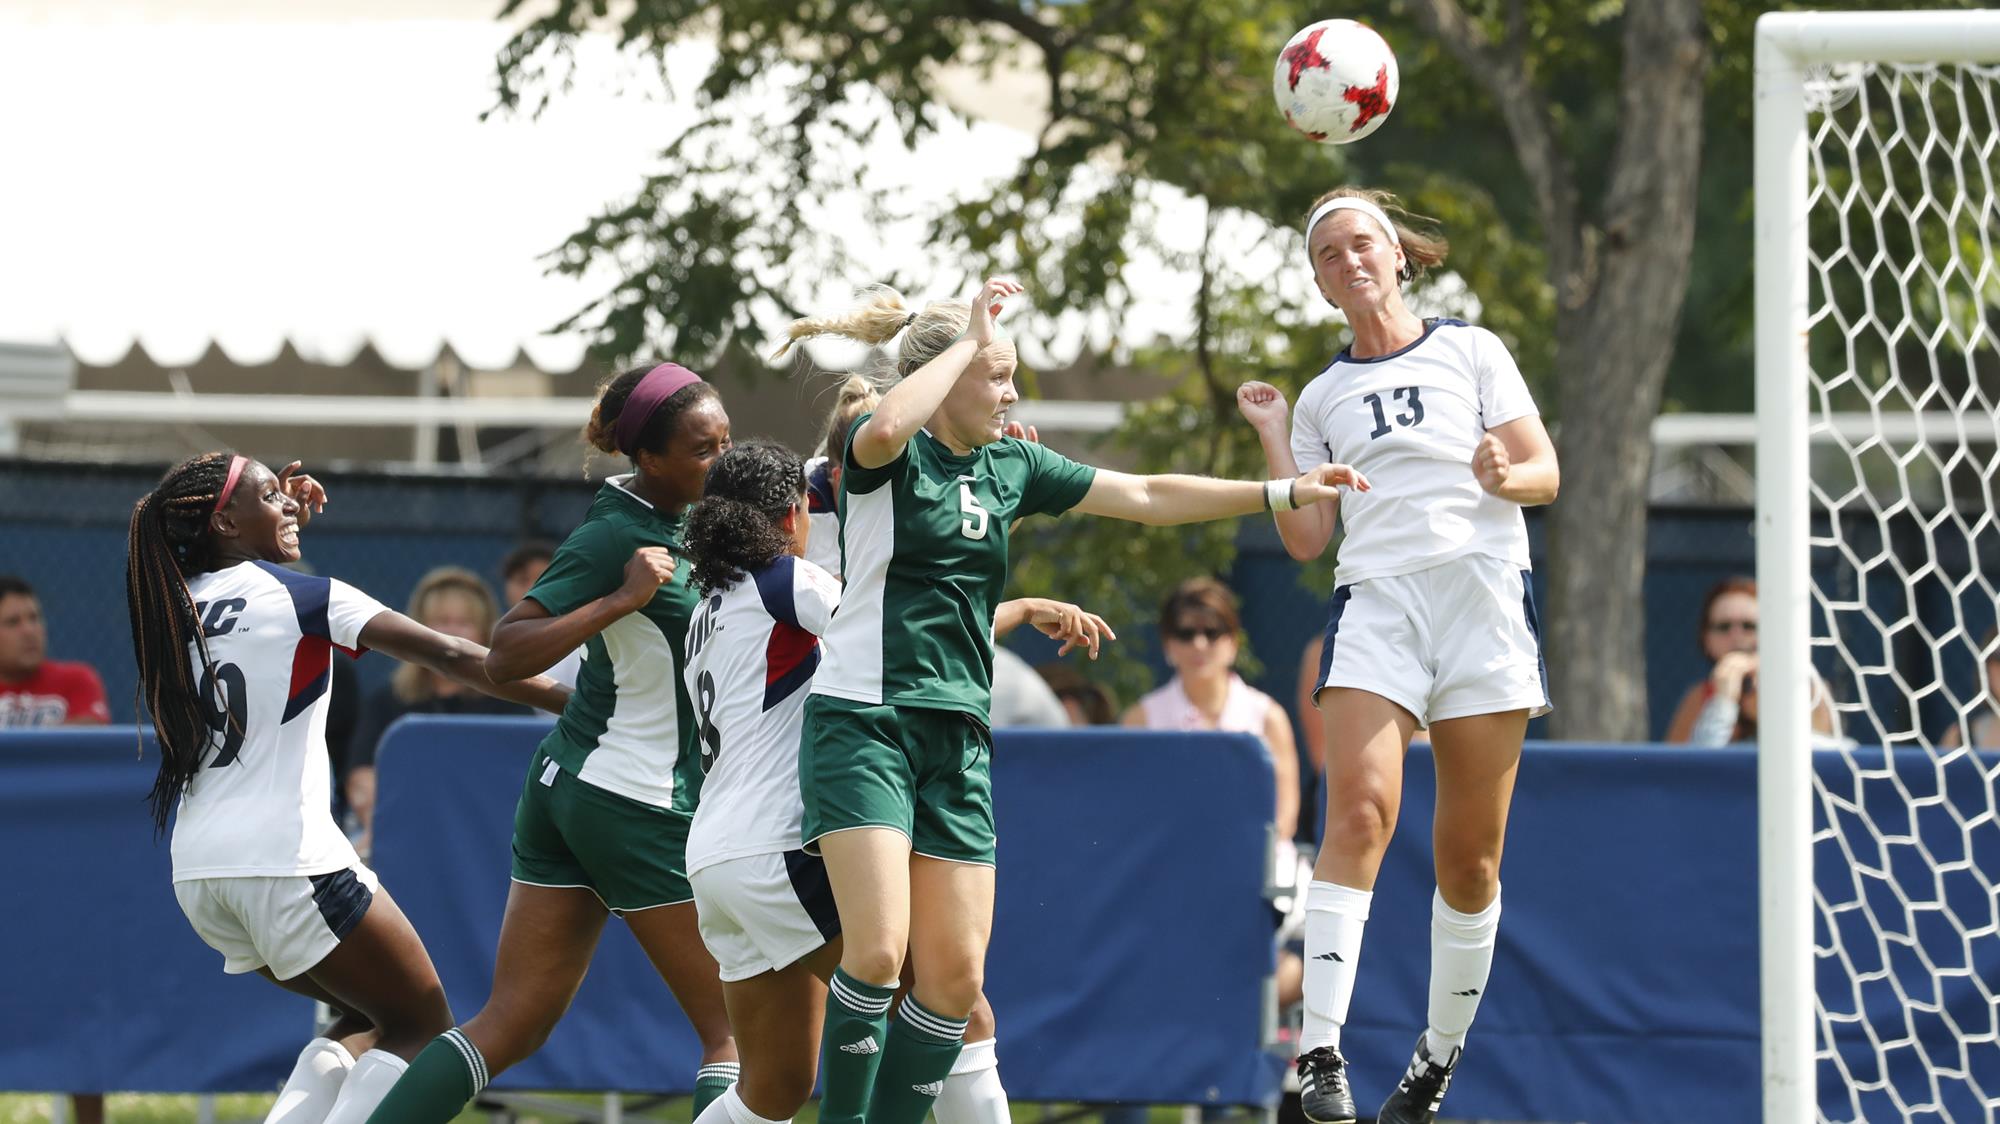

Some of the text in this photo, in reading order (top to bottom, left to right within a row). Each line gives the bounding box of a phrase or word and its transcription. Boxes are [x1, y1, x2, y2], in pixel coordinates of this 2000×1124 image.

[1363, 386, 1425, 441] 13
[957, 475, 989, 540] 5
[200, 660, 247, 768] 9
[697, 670, 721, 776] 8
